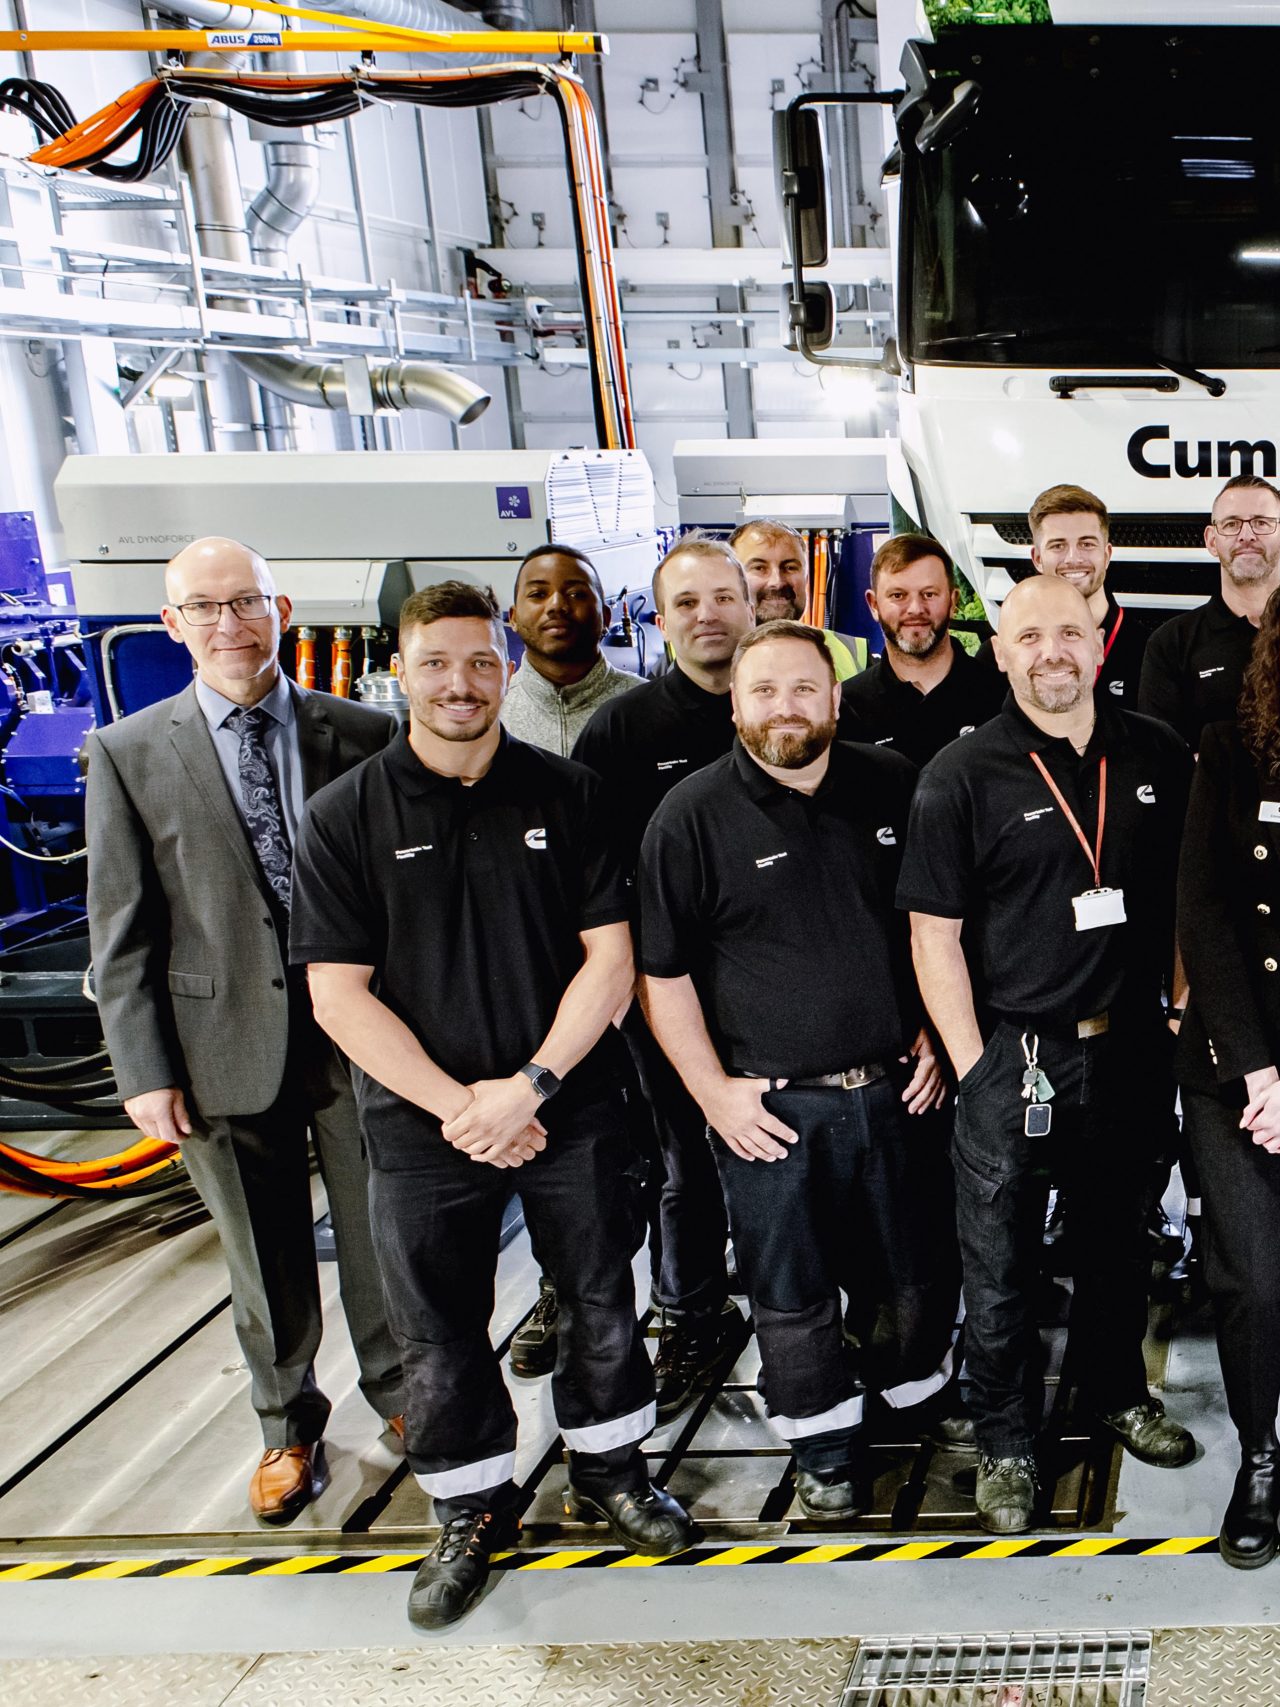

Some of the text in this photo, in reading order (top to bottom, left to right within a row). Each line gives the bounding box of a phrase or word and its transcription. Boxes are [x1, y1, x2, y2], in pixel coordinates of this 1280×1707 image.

[211, 34, 279, 45] ABUS 250kg
[500, 510, 517, 518] AVL
[119, 535, 197, 544] AVL DYNOFORCE
